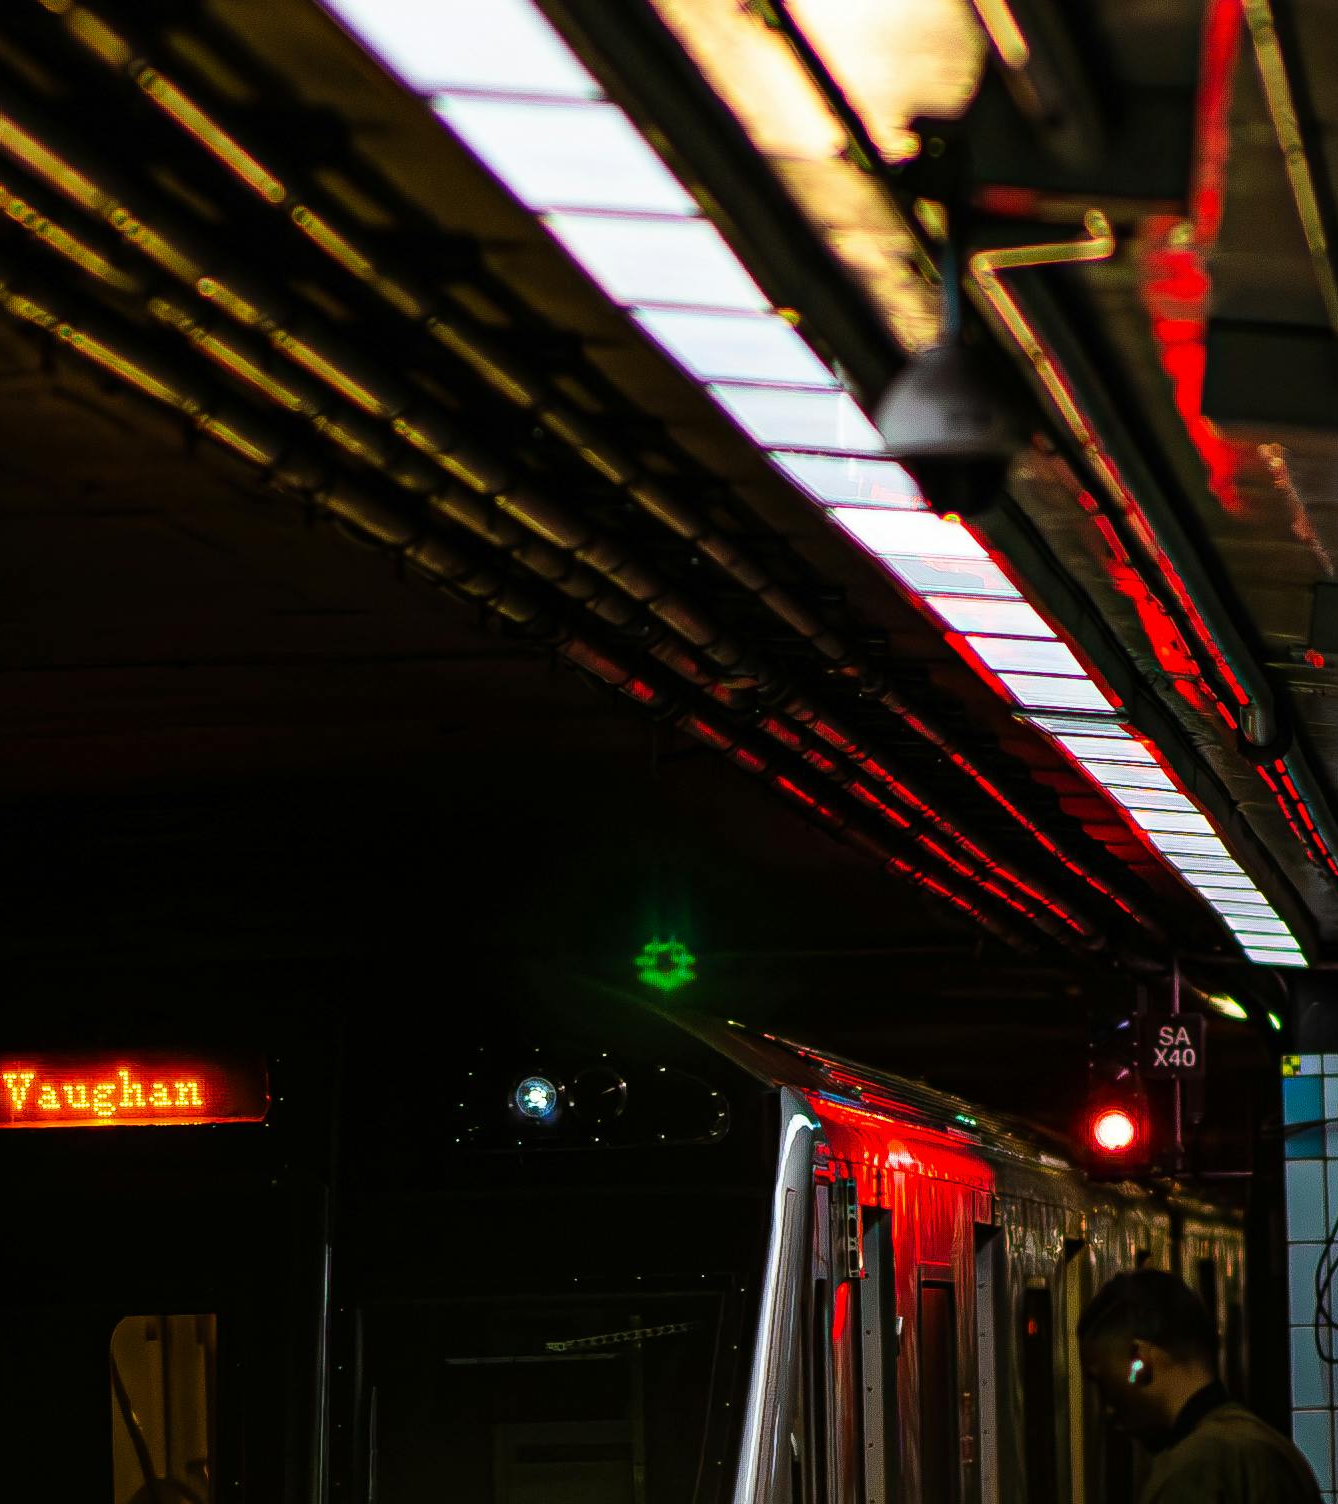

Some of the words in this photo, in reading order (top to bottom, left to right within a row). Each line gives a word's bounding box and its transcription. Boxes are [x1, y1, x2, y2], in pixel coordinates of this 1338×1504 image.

[1158, 1026, 1192, 1046] SA
[1152, 1047, 1196, 1068] X40
[2, 1069, 203, 1117] Vaughan
